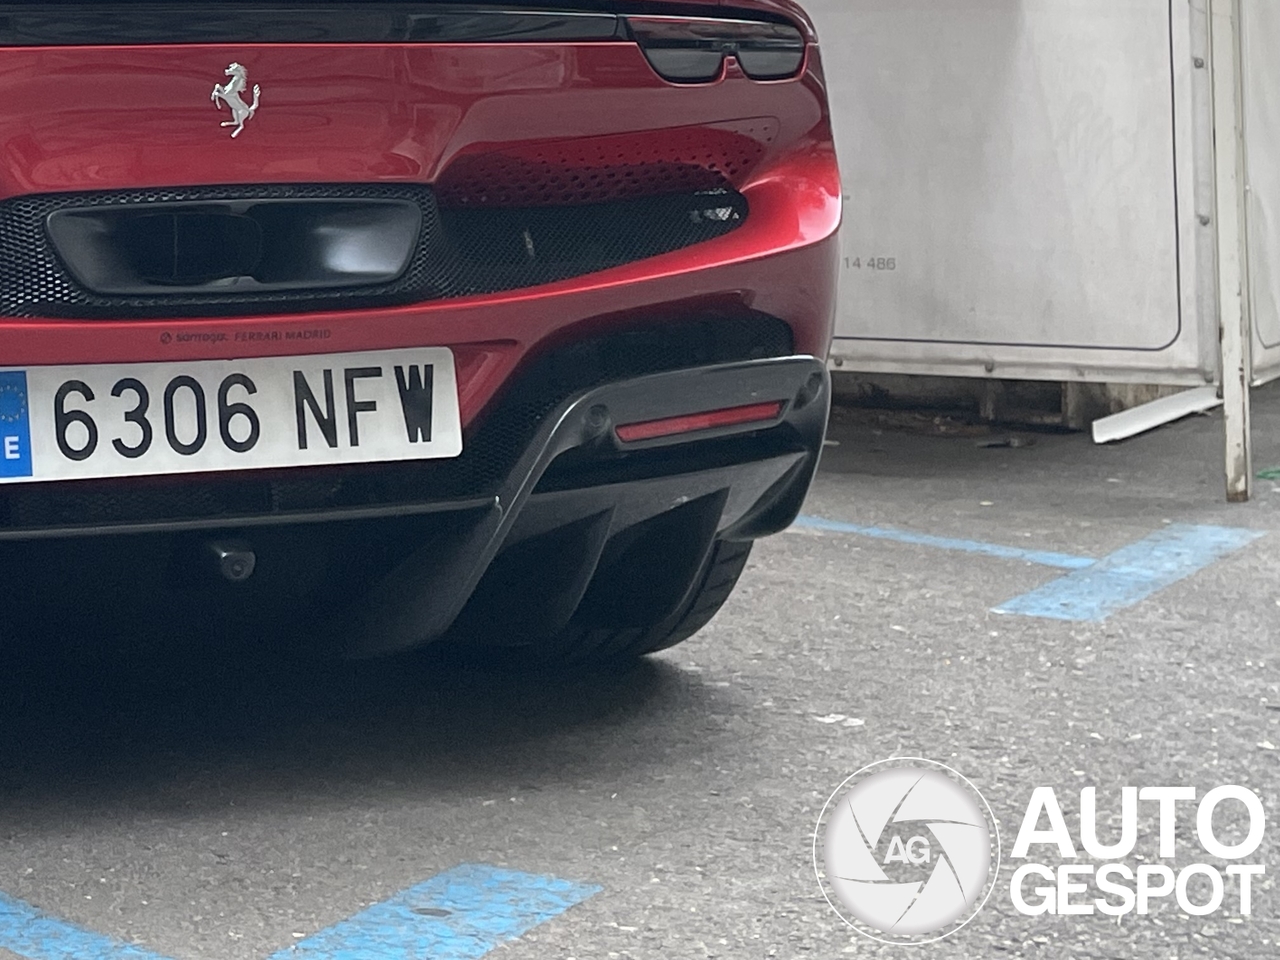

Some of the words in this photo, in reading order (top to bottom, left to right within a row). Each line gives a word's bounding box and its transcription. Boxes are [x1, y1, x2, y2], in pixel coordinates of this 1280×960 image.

[866, 256, 896, 271] 486
[234, 331, 282, 342] FERRARI
[285, 328, 332, 340] MADRID
[53, 372, 261, 462] 6306
[292, 363, 435, 451] NFW
[3, 435, 21, 460] E
